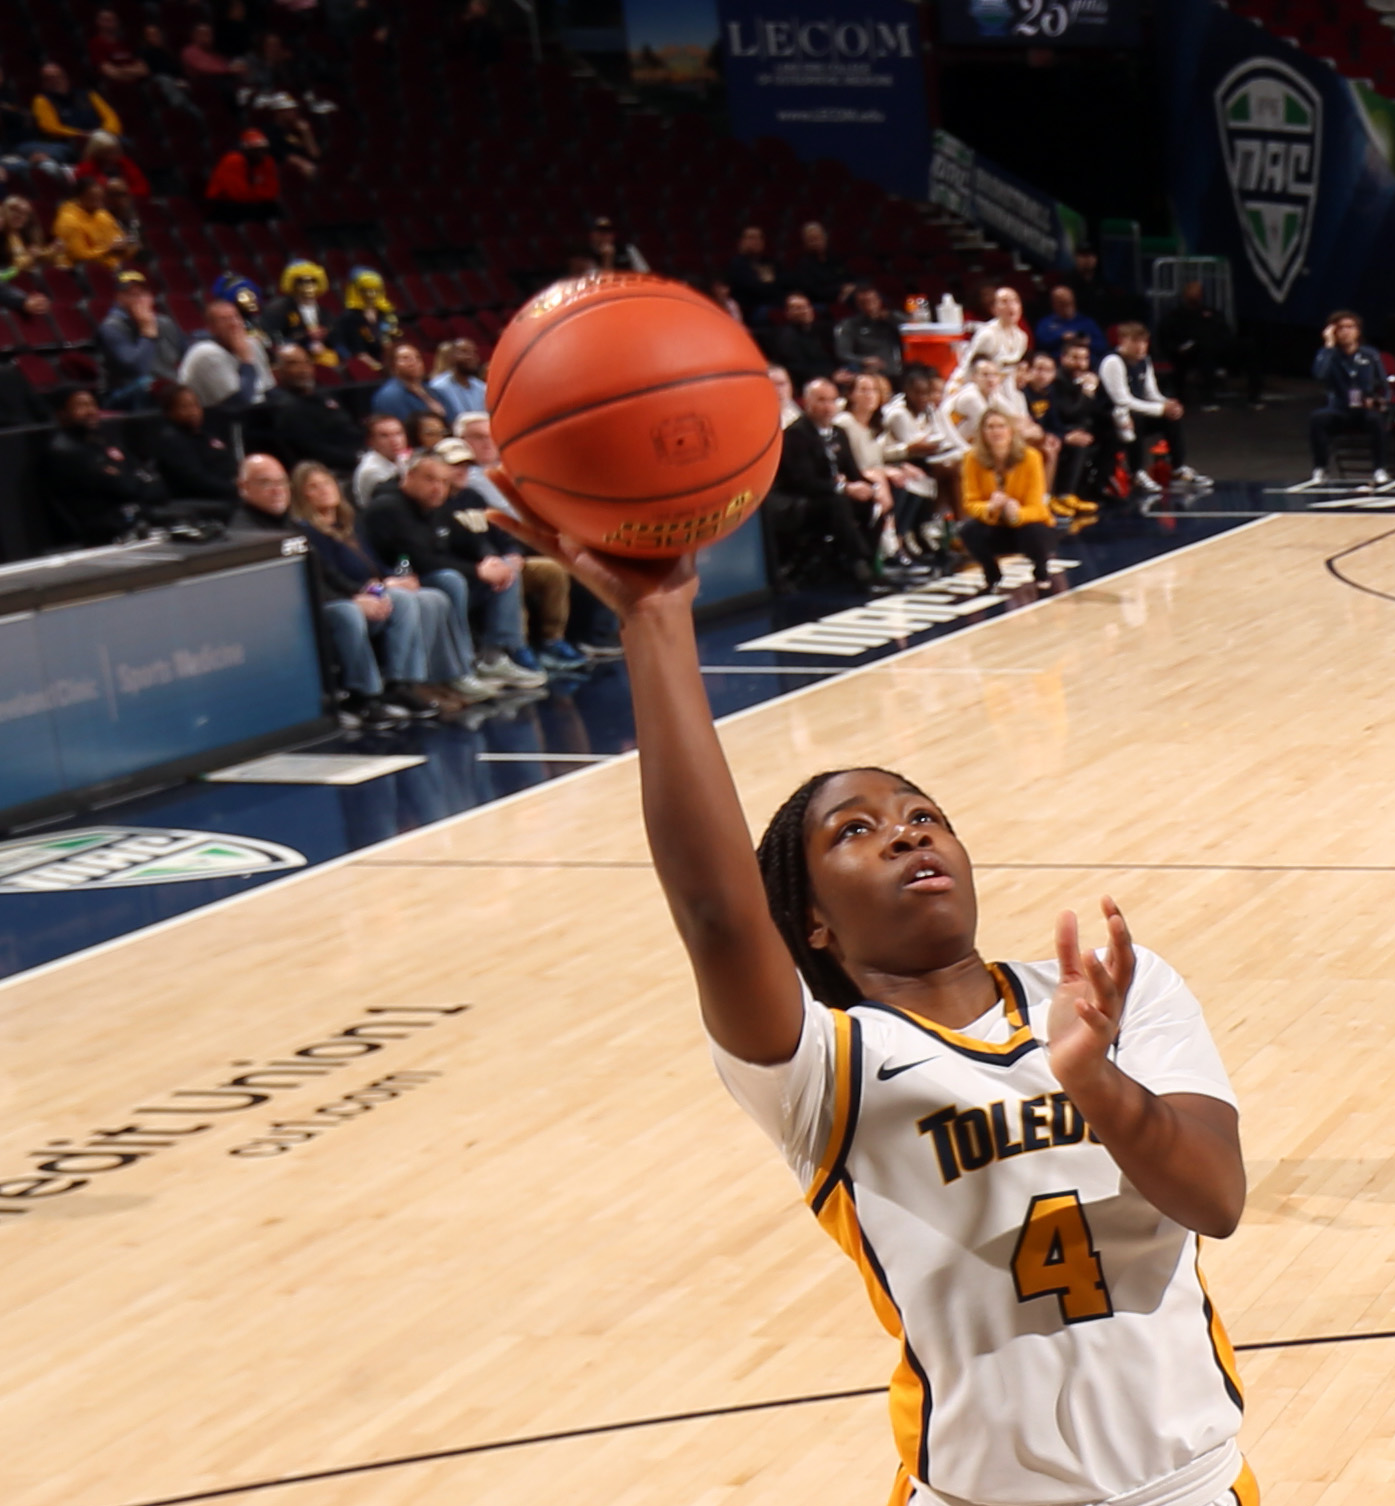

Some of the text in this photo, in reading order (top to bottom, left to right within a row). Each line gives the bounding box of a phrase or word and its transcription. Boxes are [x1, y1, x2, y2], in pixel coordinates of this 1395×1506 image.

[1232, 136, 1313, 197] MAC
[917, 1090, 1105, 1185] TOLED
[1010, 1189, 1114, 1326] 4
